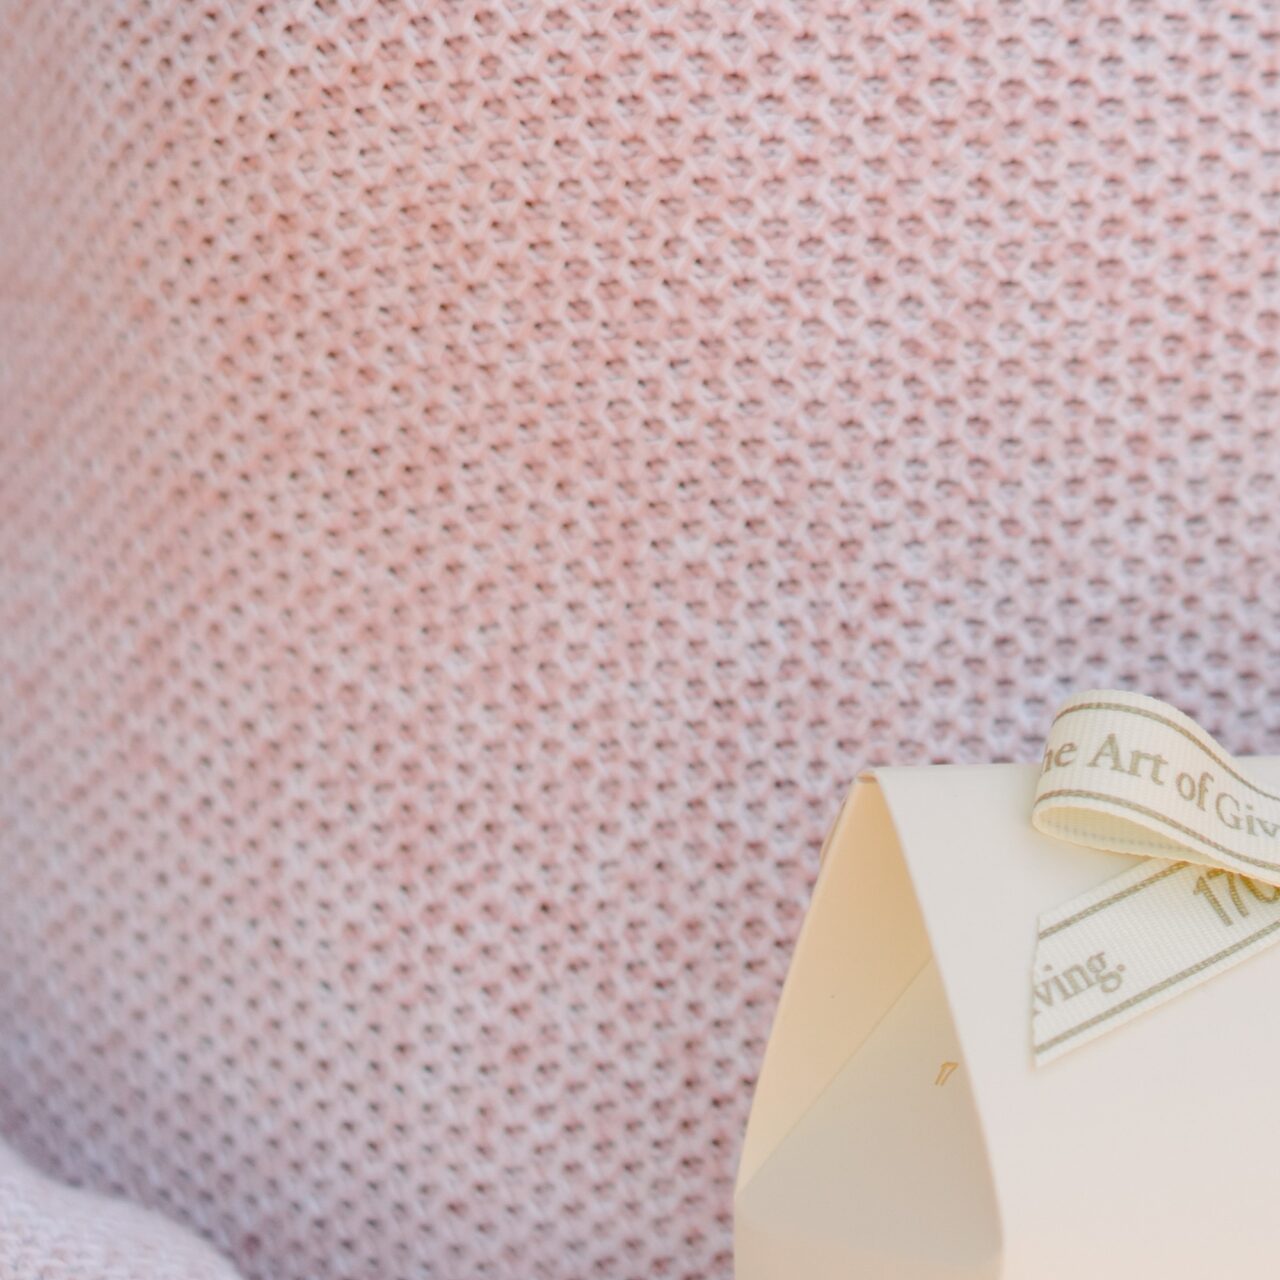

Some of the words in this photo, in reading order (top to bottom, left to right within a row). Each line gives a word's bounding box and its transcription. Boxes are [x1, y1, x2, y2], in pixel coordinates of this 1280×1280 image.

[1086, 732, 1168, 786] Art
[1175, 771, 1215, 812] of
[1032, 949, 1127, 1012] ving.
